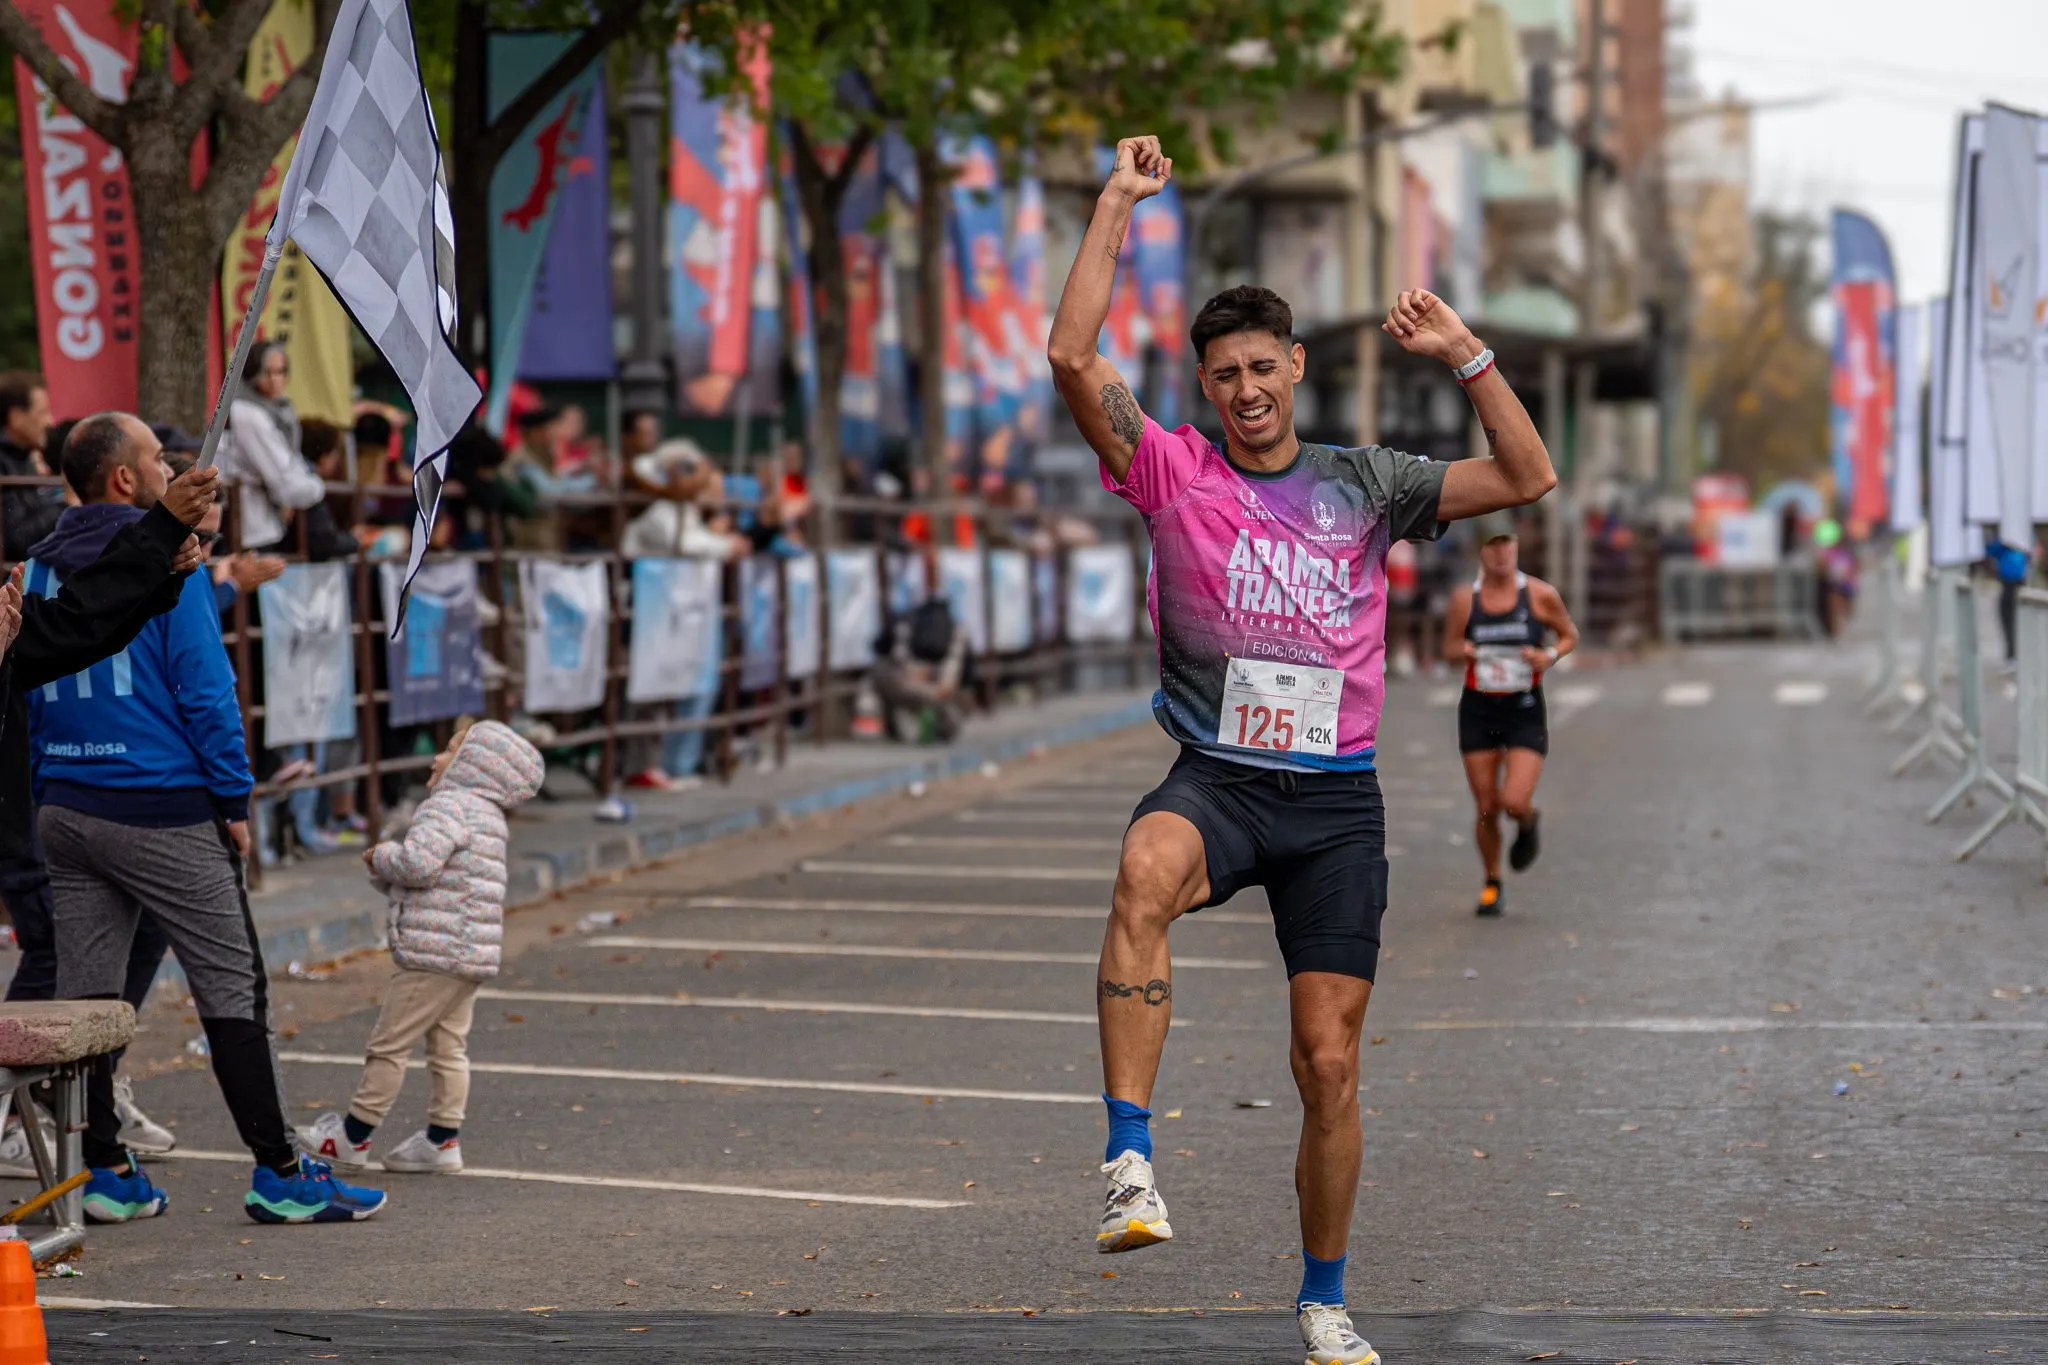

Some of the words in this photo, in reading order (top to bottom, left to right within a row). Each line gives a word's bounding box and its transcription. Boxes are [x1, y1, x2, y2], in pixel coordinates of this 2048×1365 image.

[1304, 533, 1330, 542] Santa
[1331, 533, 1352, 541] Rosa
[1235, 703, 1295, 751] 125
[1306, 727, 1332, 745] 42K
[45, 742, 81, 756] Santa
[84, 742, 127, 756] Rosa
